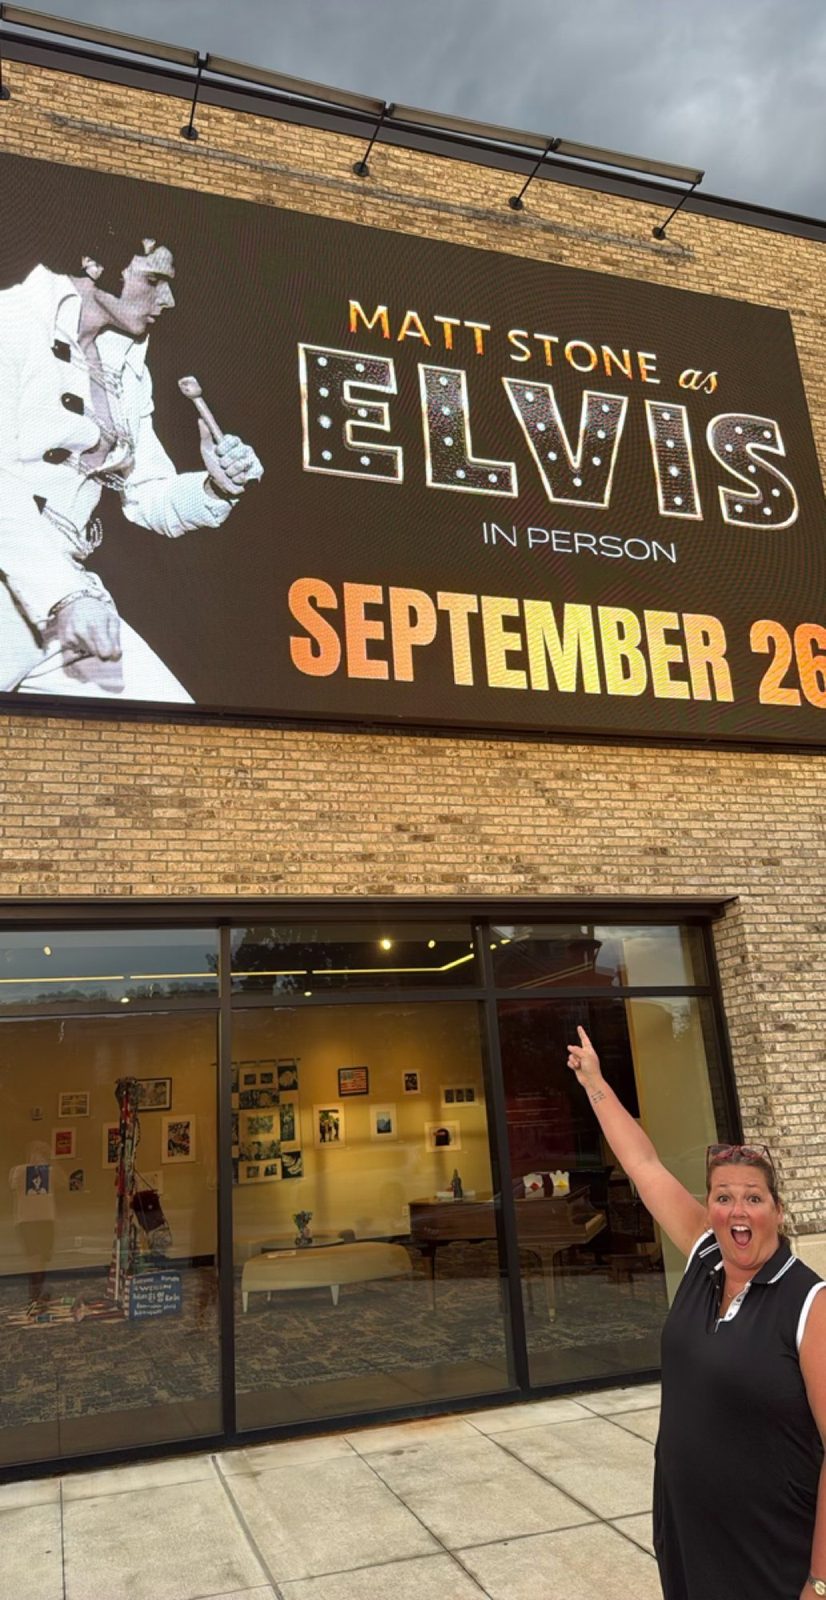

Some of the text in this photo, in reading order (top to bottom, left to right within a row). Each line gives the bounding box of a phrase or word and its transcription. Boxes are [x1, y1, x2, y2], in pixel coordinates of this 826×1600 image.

[348, 300, 718, 394] MATT STONE as
[298, 343, 798, 530] ELVIS
[481, 521, 678, 564] IN PERSON
[288, 578, 826, 709] SEPTEMBER 26
